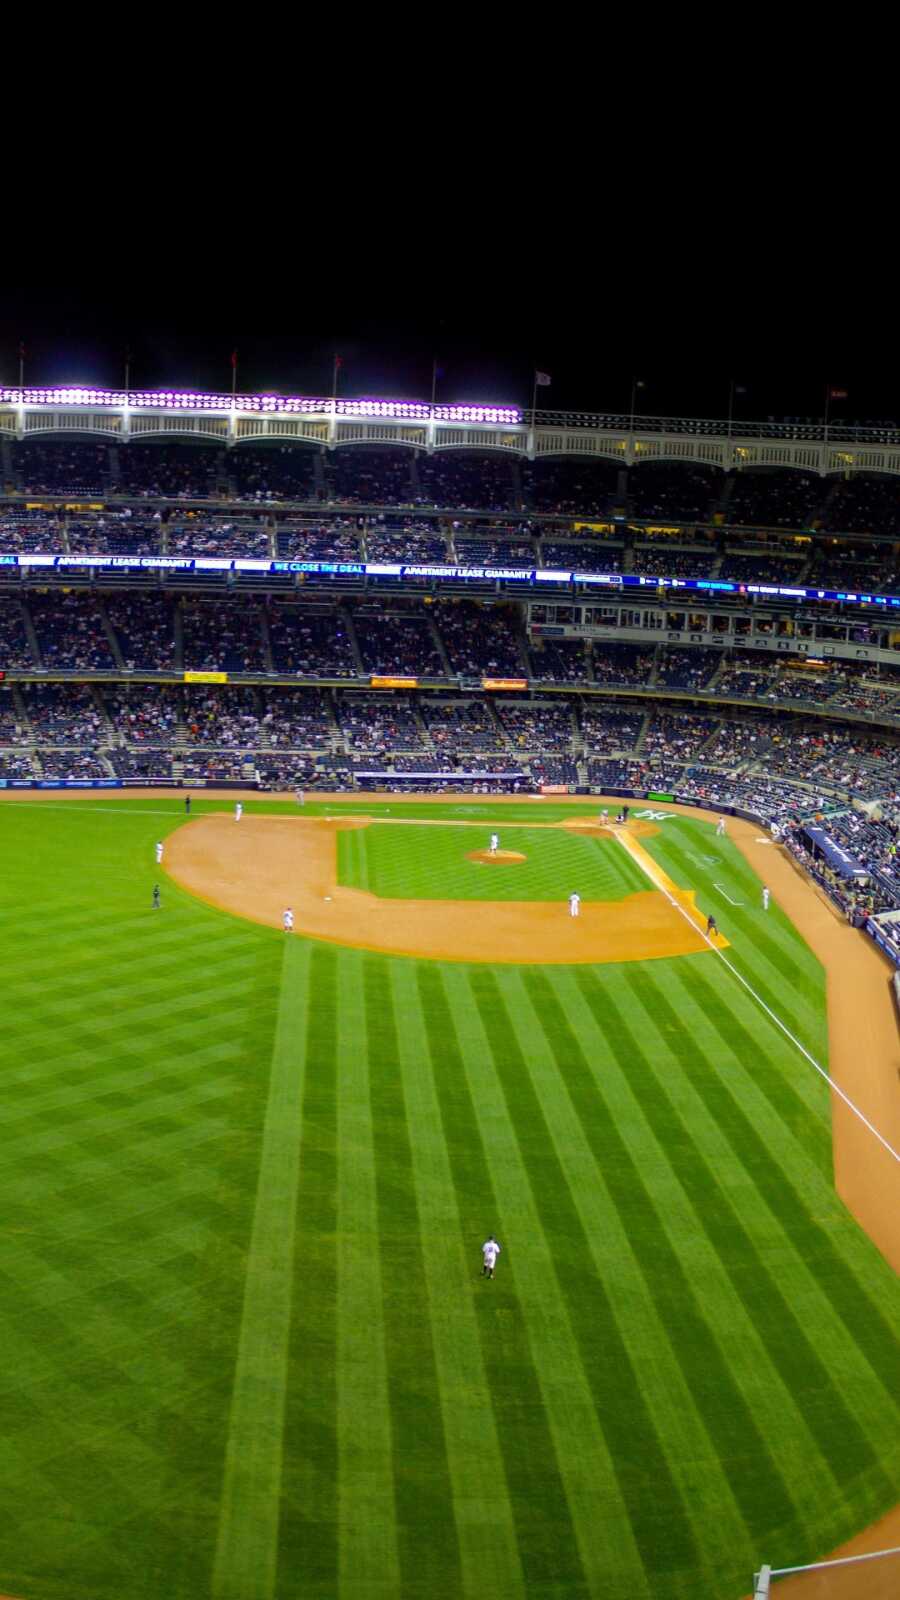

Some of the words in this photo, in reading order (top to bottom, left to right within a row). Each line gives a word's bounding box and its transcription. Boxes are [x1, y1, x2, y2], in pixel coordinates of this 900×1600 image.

[58, 557, 111, 566] APARTMENT
[113, 558, 140, 567] LEASE
[274, 562, 289, 571] WE
[290, 563, 320, 572] CLOSE
[321, 564, 338, 573] THE
[340, 565, 363, 573] DEAL
[403, 566, 456, 576] APARTMENT
[458, 568, 484, 577] LEASE
